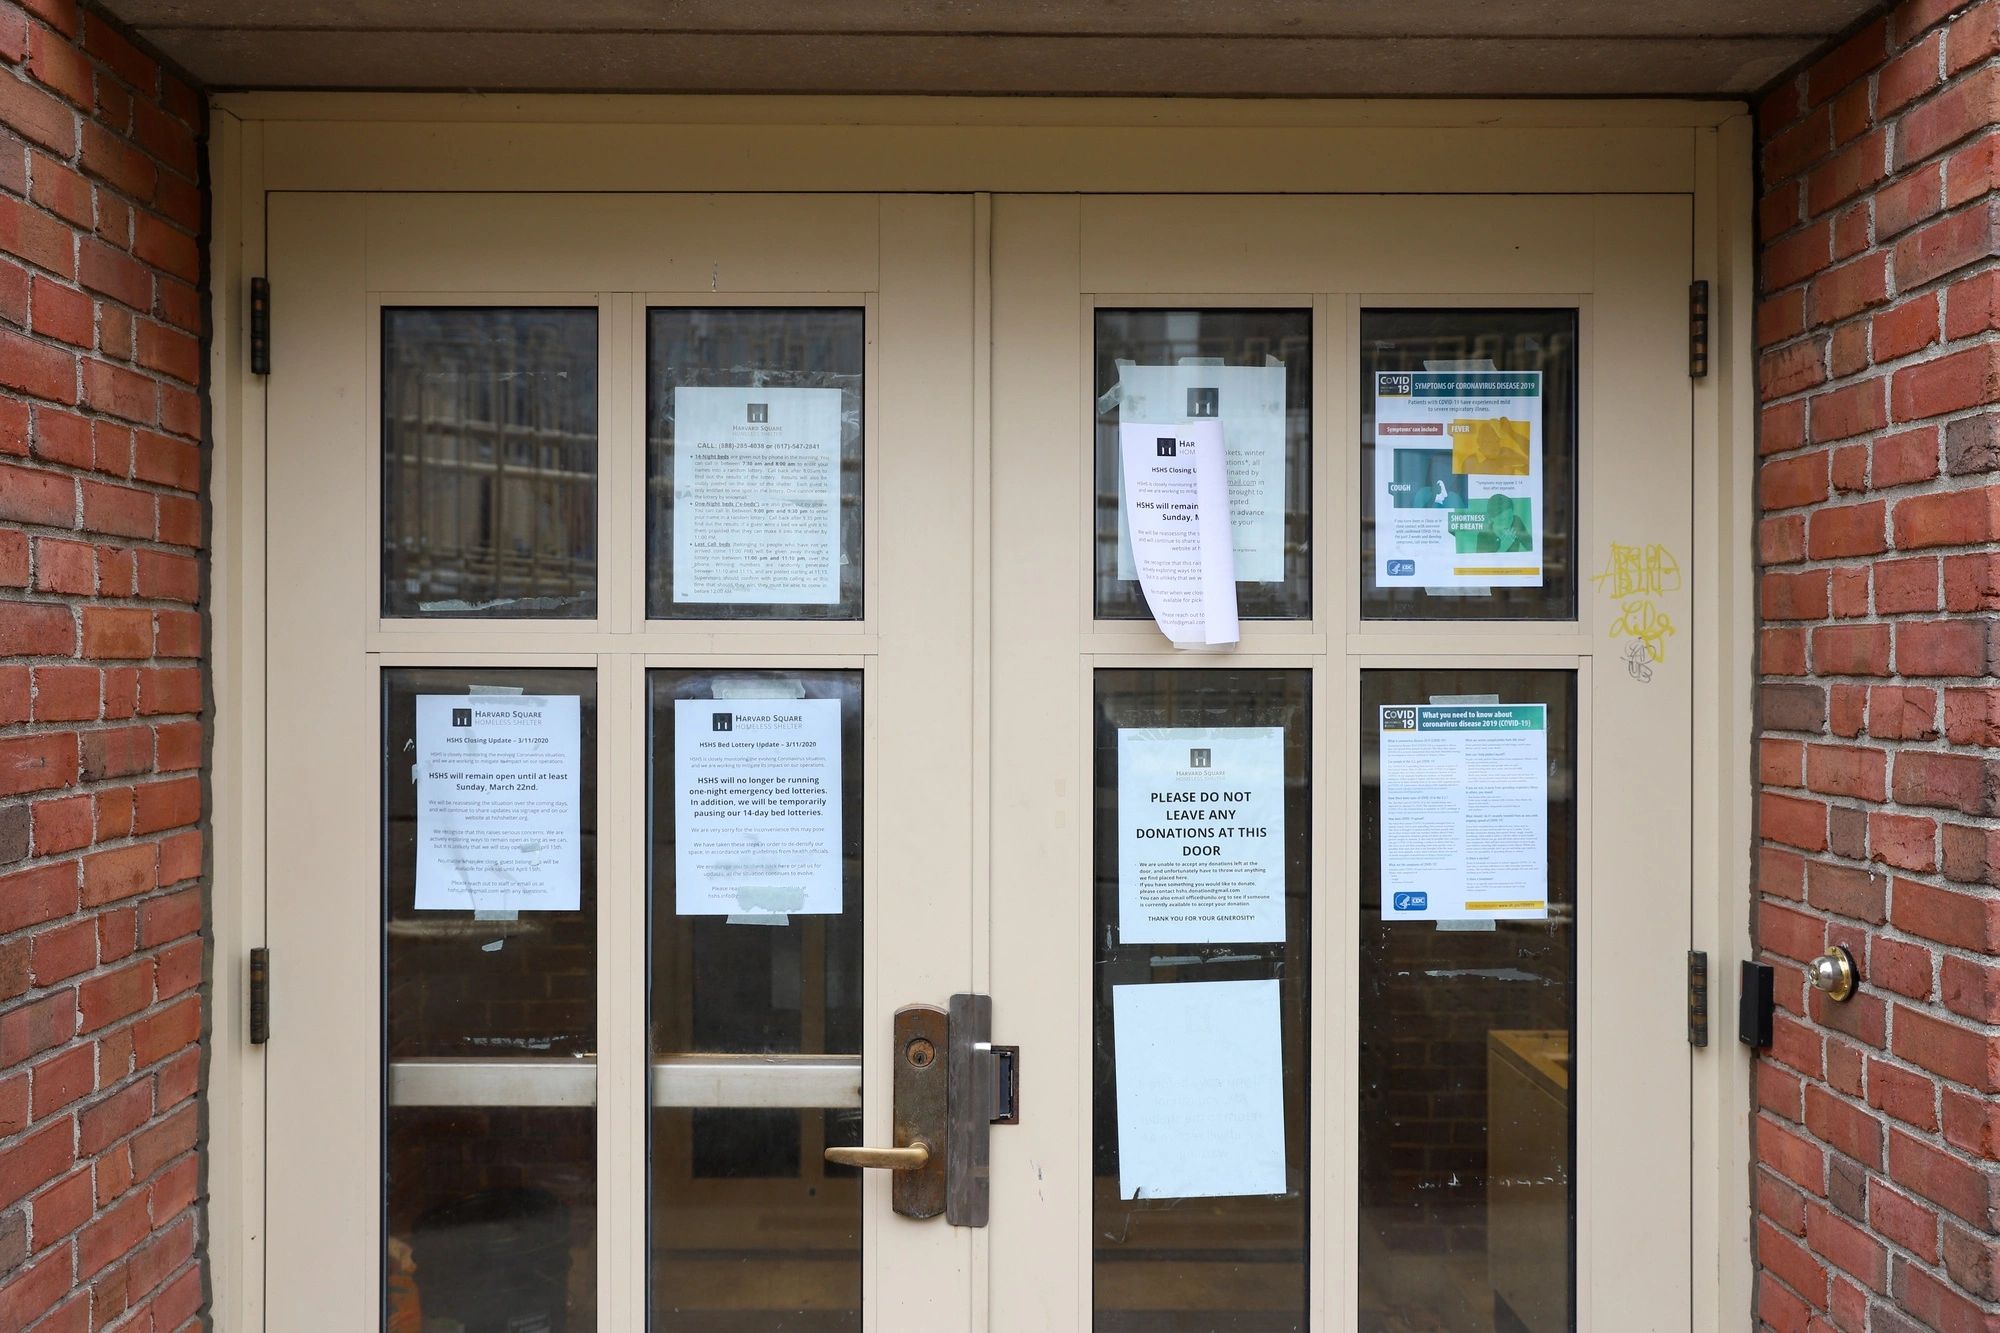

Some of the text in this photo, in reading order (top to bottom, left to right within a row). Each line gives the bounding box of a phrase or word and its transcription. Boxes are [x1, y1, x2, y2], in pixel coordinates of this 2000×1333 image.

[1397, 384, 1409, 394] 19
[1414, 382, 1535, 390] SYMPTOMS OF CORONAVIRUS DISEASE 2019
[1451, 425, 1470, 433] FEVER
[1168, 467, 1192, 475] Closing
[1390, 484, 1411, 492] COUGH
[1136, 502, 1199, 510] HSHS will remain
[1162, 513, 1193, 522] Sunday,
[1450, 522, 1459, 530] OF
[1422, 711, 1439, 719] What
[1439, 712, 1452, 720] you
[1451, 711, 1468, 719] need
[1493, 710, 1513, 718] about
[1402, 719, 1414, 729] 19
[1422, 720, 1458, 728] coronavirus
[1458, 720, 1482, 728] disease
[463, 737, 488, 745] Closing
[488, 737, 512, 745] Update
[428, 772, 449, 780] HSHS
[449, 772, 464, 780] will
[465, 772, 494, 780] remain
[495, 774, 516, 782] open
[517, 772, 537, 780] until
[548, 772, 568, 780] least
[720, 776, 735, 784] will
[748, 776, 774, 785] longer
[776, 776, 786, 784] be
[787, 776, 820, 785] running
[456, 783, 538, 793] Sunday, March 22nd.
[689, 787, 828, 797] one-night emergency bed lotteries.
[1151, 791, 1252, 803] PLEASE DO NOT
[700, 798, 736, 807] addition,
[751, 798, 766, 806] will
[767, 798, 778, 806] be
[779, 797, 827, 807] temporarily
[694, 809, 726, 818] pausing
[743, 809, 769, 818] 14-day
[770, 809, 786, 817] bed
[1166, 809, 1236, 821] LEAVE ANY
[1136, 827, 1267, 839] DONATIONS AT THIS
[1182, 845, 1221, 856] DOOR
